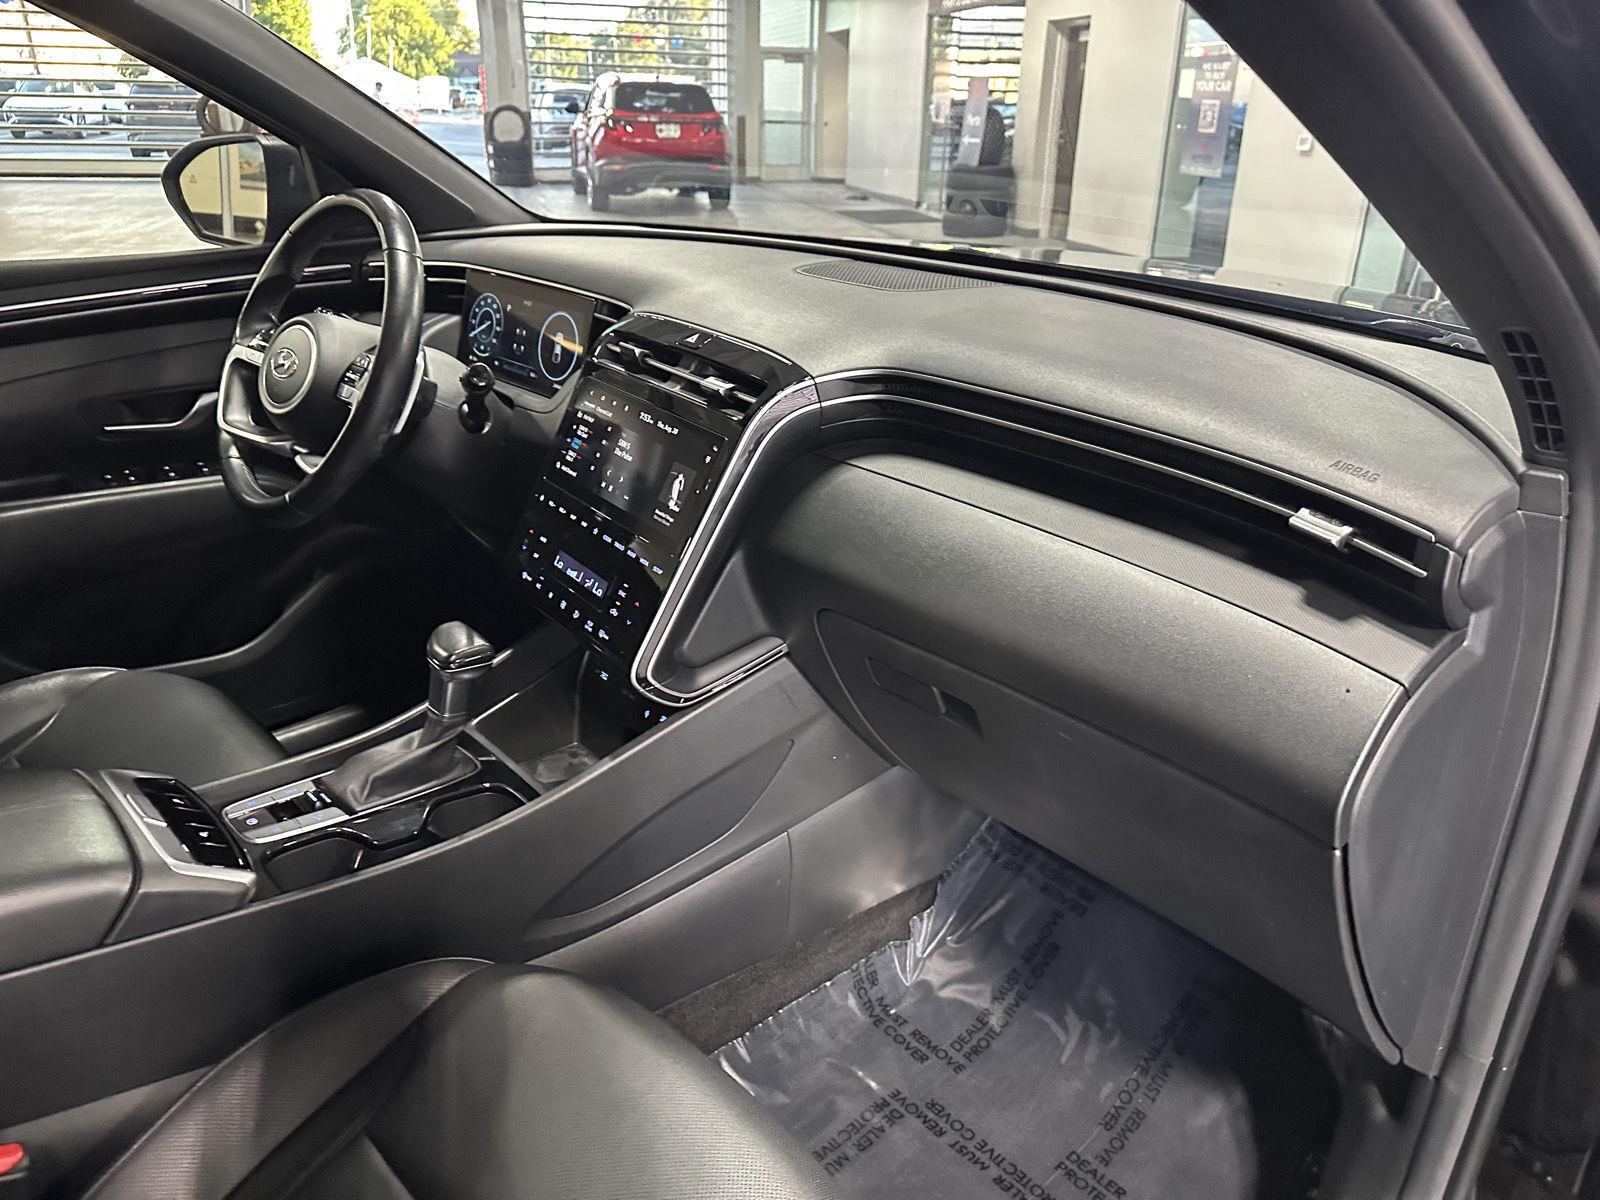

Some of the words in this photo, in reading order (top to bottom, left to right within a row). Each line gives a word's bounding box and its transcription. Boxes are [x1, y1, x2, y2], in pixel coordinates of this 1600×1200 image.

[1329, 460, 1382, 483] AIRBAG
[950, 1008, 994, 1053] DEALER
[991, 968, 1023, 1006] MUST
[963, 988, 1028, 1063] PROTECTIVE
[876, 996, 908, 1027] MUST
[909, 1028, 966, 1075] REMOVE
[884, 1025, 930, 1065] COVER
[1099, 1078, 1140, 1132] COVER
[1144, 1060, 1174, 1104] MUST
[811, 1097, 891, 1163] PROTECTIVE
[852, 1107, 904, 1152] DEALER
[887, 1089, 948, 1138] REMOVE
[925, 1099, 976, 1141] COVER
[1095, 1107, 1146, 1168] REMOVE
[948, 1139, 990, 1171] MUST
[1066, 1151, 1127, 1199] DEALER
